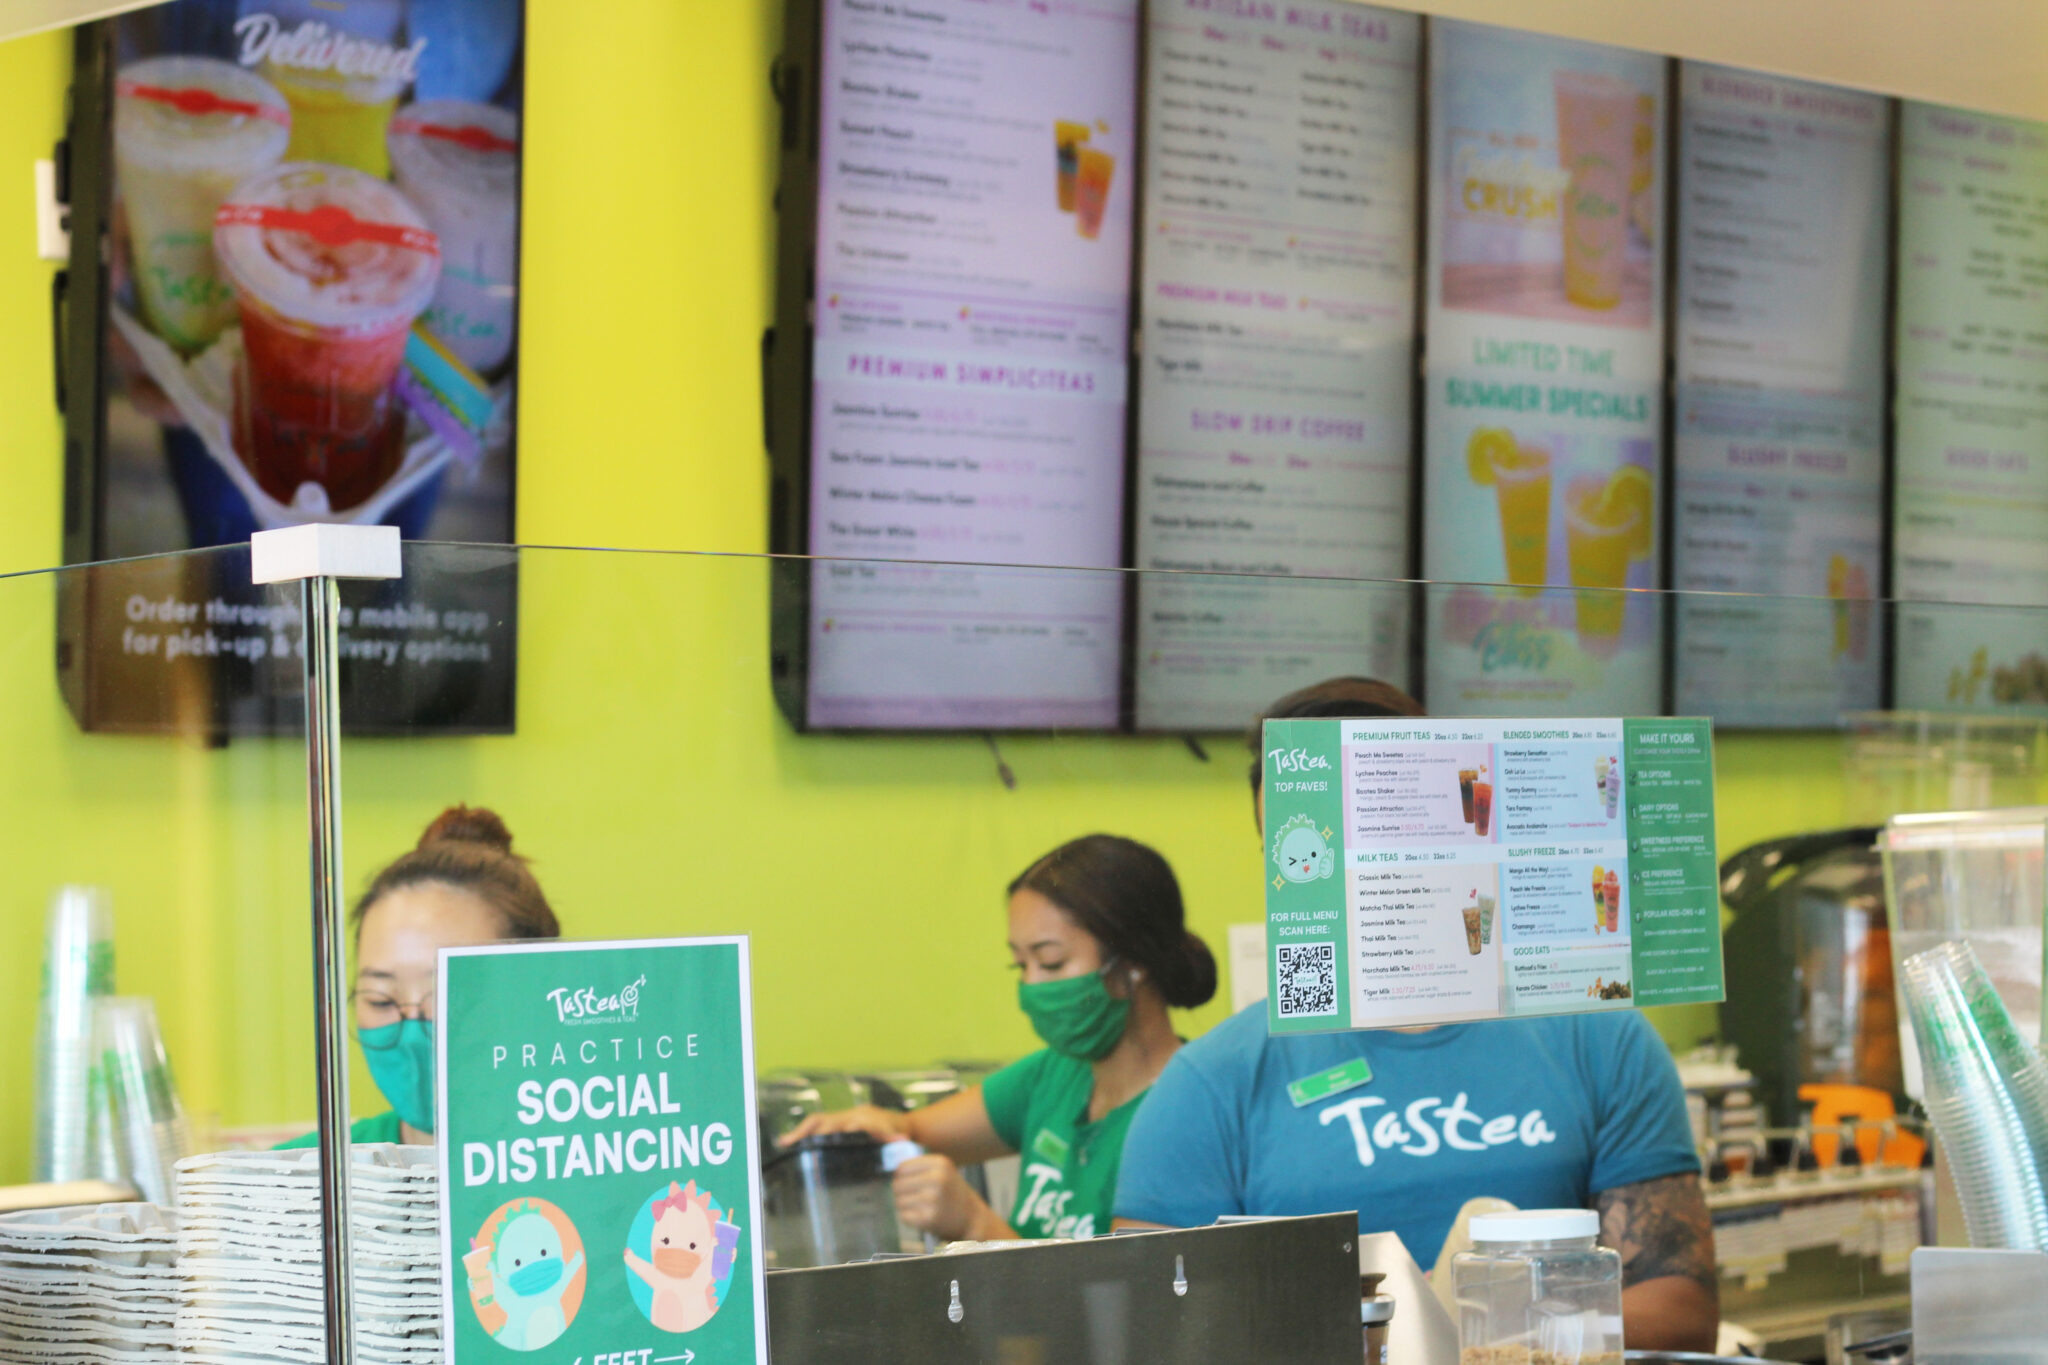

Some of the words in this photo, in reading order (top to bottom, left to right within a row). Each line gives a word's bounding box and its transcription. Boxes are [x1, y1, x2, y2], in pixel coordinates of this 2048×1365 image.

[234, 14, 427, 79] Delivered
[1463, 178, 1560, 219] CRUSH
[1473, 336, 1560, 371] LIMITED
[1566, 345, 1615, 377] TIME
[848, 355, 946, 380] PREMIUM
[955, 361, 1095, 393] SIMPLICITEAS
[1446, 377, 1541, 412] SUMMER
[1548, 387, 1649, 422] SPECIALS
[1191, 411, 1243, 432] SLOW
[1300, 416, 1366, 442] COFFEE
[127, 596, 197, 623] Order
[206, 598, 302, 631] through
[359, 603, 438, 628] mobile
[444, 608, 489, 635] app
[123, 628, 158, 656] for
[165, 629, 266, 663] pick-up
[272, 634, 290, 657] &
[405, 636, 490, 664] options
[1353, 732, 1389, 740] PREMIUM
[1391, 732, 1411, 740] FRUIT
[1413, 731, 1430, 740] TEAS
[1504, 731, 1532, 740] BLENDED
[1532, 731, 1569, 739] SMOOTHIES
[1640, 734, 1660, 744] MAKE
[1661, 734, 1668, 744] IT
[1670, 733, 1695, 744] YOURS
[1275, 782, 1294, 792] TOP
[1296, 781, 1328, 792] FAVES!
[1382, 824, 1400, 832] Sunrise
[1358, 854, 1378, 862] MILK
[1380, 853, 1398, 862] TEAS
[1508, 848, 1532, 856] SLUSHY
[1534, 847, 1556, 856] FREEZE
[1271, 913, 1289, 922] FOR
[1290, 912, 1311, 921] FULL
[1313, 910, 1338, 920] MENU
[1279, 926, 1304, 936] SCAN
[1305, 925, 1330, 935] HERE:
[1514, 947, 1534, 956] GOOD
[1536, 946, 1550, 954] EATS
[493, 1034, 699, 1069] PRACTICE
[517, 1072, 681, 1125] SOCIAL
[463, 1122, 733, 1187] DISTANCING
